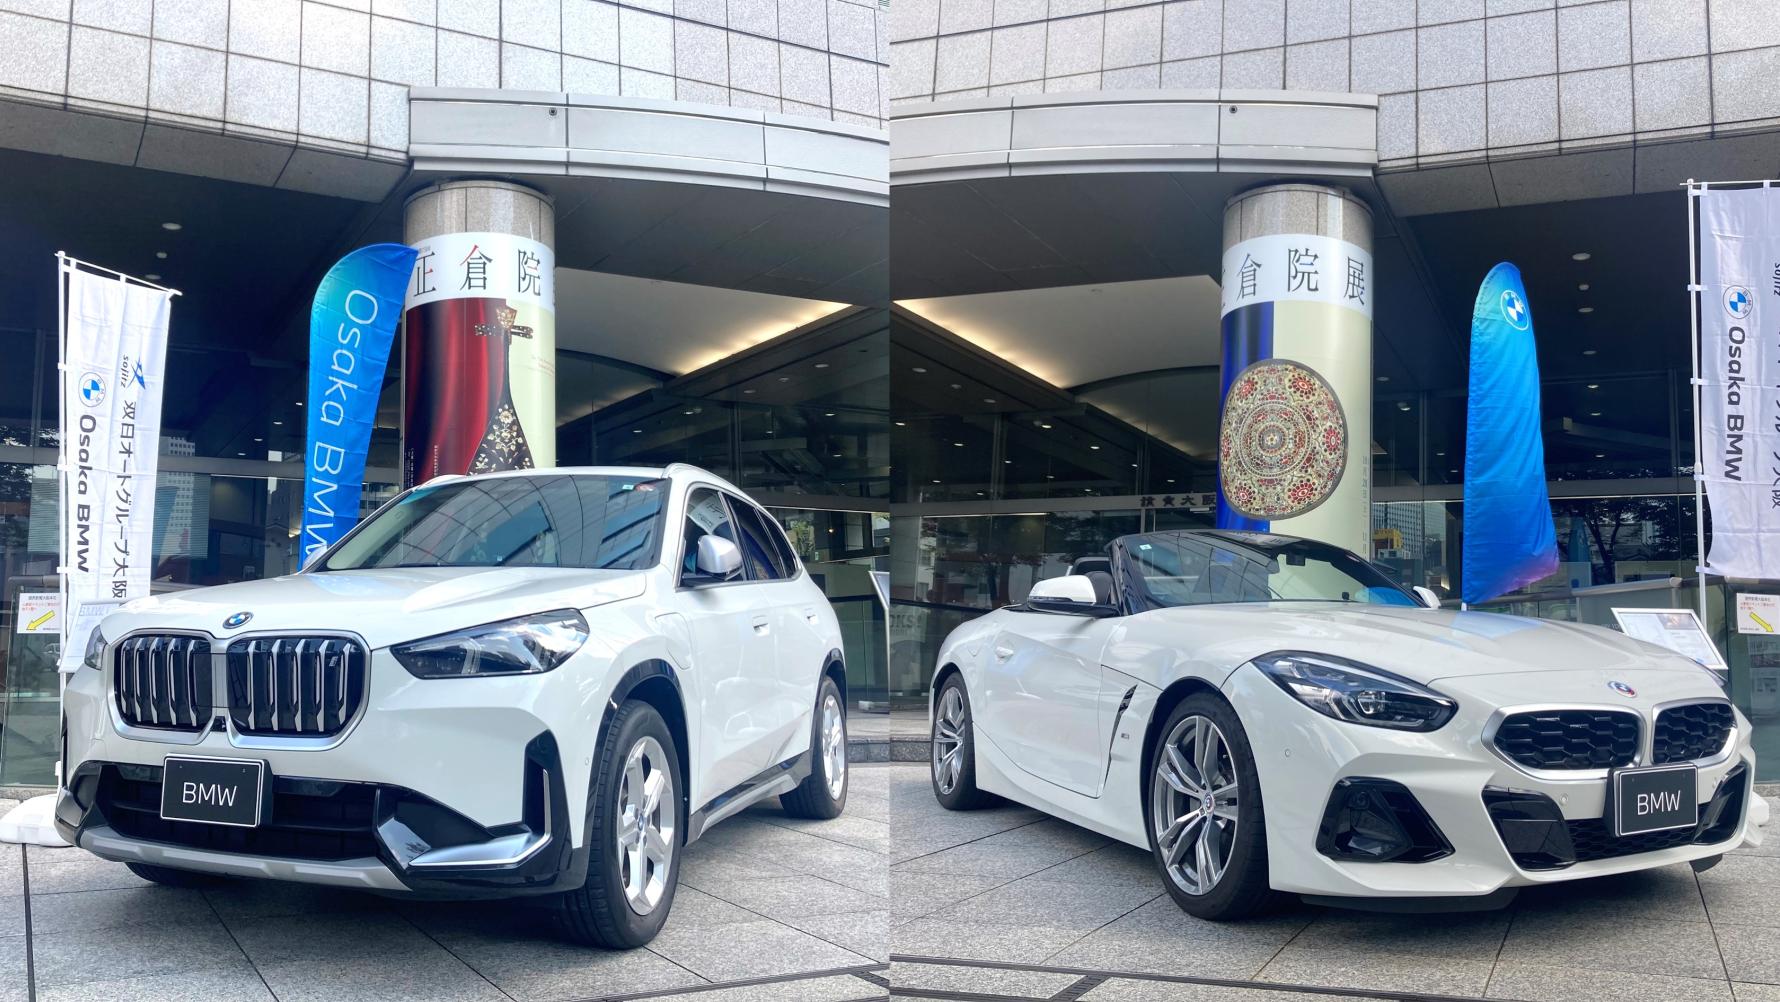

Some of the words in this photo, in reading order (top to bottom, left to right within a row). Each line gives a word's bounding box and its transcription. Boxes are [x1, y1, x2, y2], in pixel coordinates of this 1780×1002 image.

[413, 244, 541, 297] 正倉院
[1221, 248, 1365, 306] 倉院展
[120, 354, 129, 388] sojitz
[320, 289, 378, 427] Osaka
[1728, 326, 1745, 406] Osaka
[78, 414, 96, 495] Osaka
[1724, 414, 1744, 482] BMW
[112, 400, 136, 599] 双日オートグループ大阪
[305, 441, 346, 555] BMW
[77, 504, 91, 573] BMW
[182, 782, 238, 807] BMW
[1637, 790, 1681, 816] BMW
